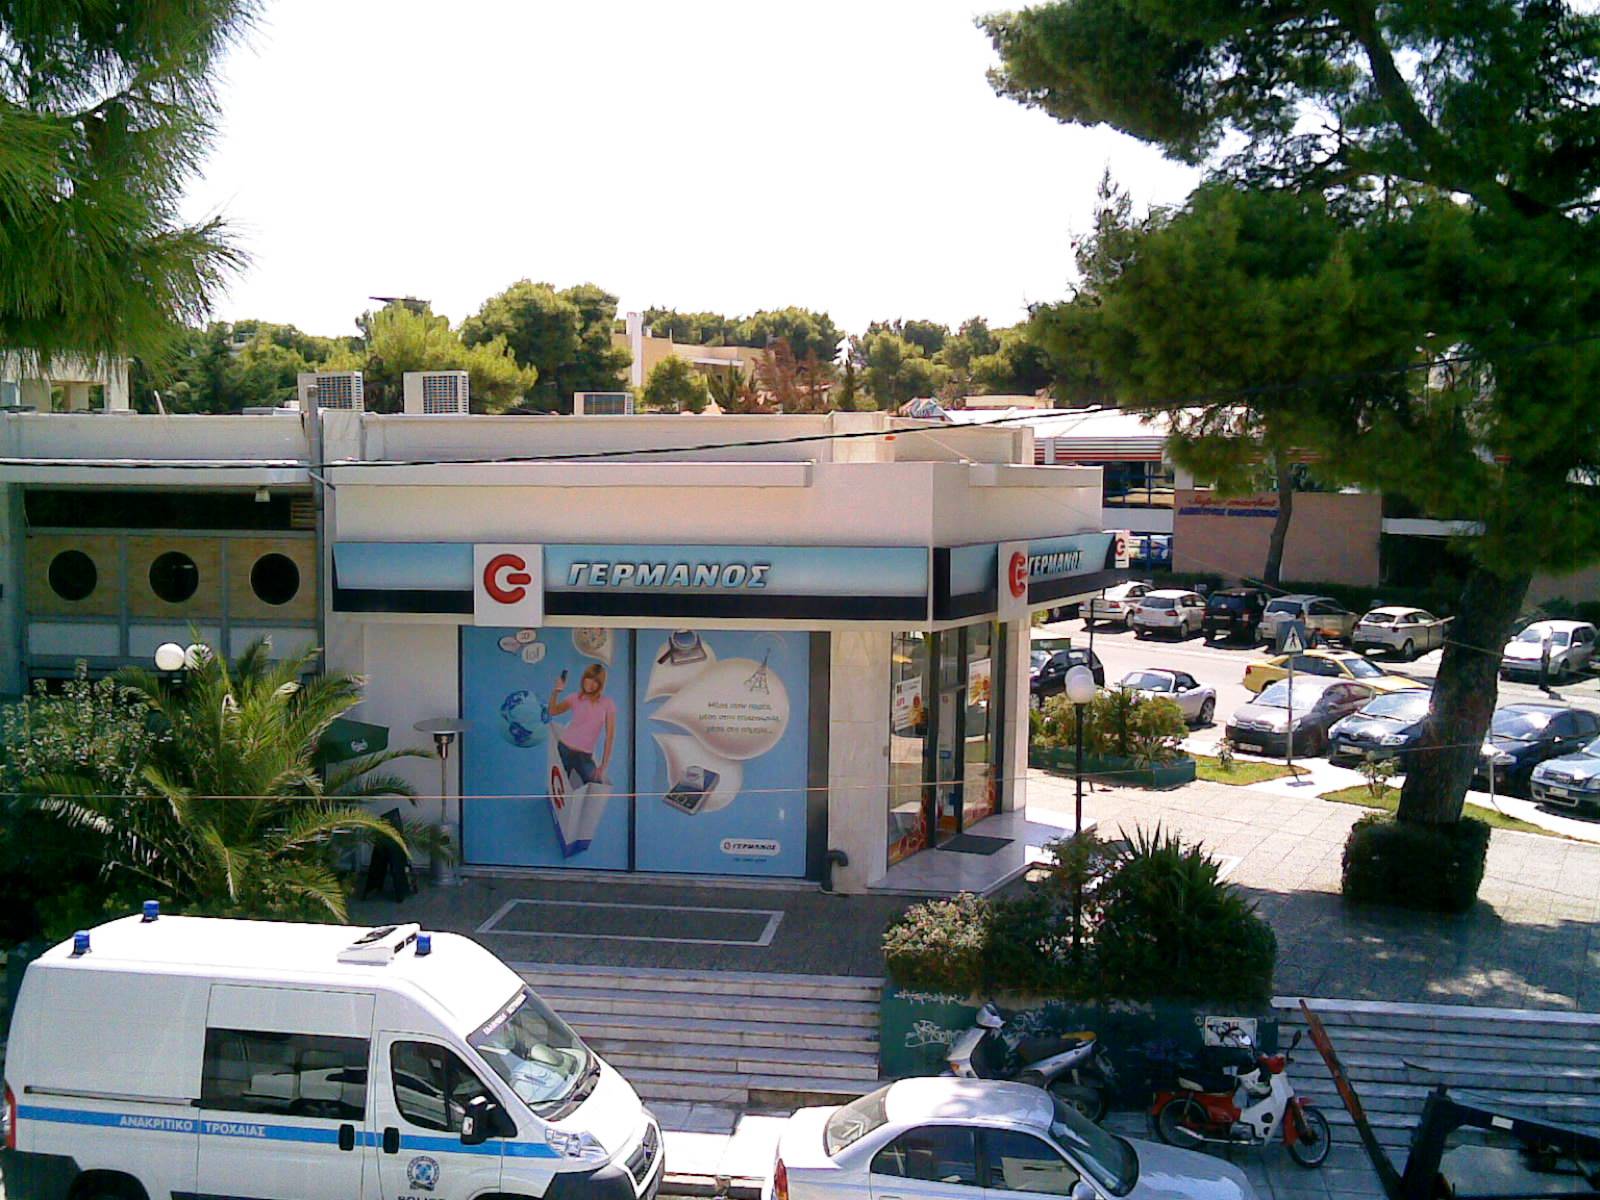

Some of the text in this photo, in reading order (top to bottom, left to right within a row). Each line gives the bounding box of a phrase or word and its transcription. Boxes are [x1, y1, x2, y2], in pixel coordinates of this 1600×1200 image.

[567, 561, 771, 589] ΓΕΡΜΑΝΟΣ
[119, 1115, 266, 1137] ΑΝΑΚΡΙΤΙΚΟ ΤΡΟΧΑΙΑΣ
